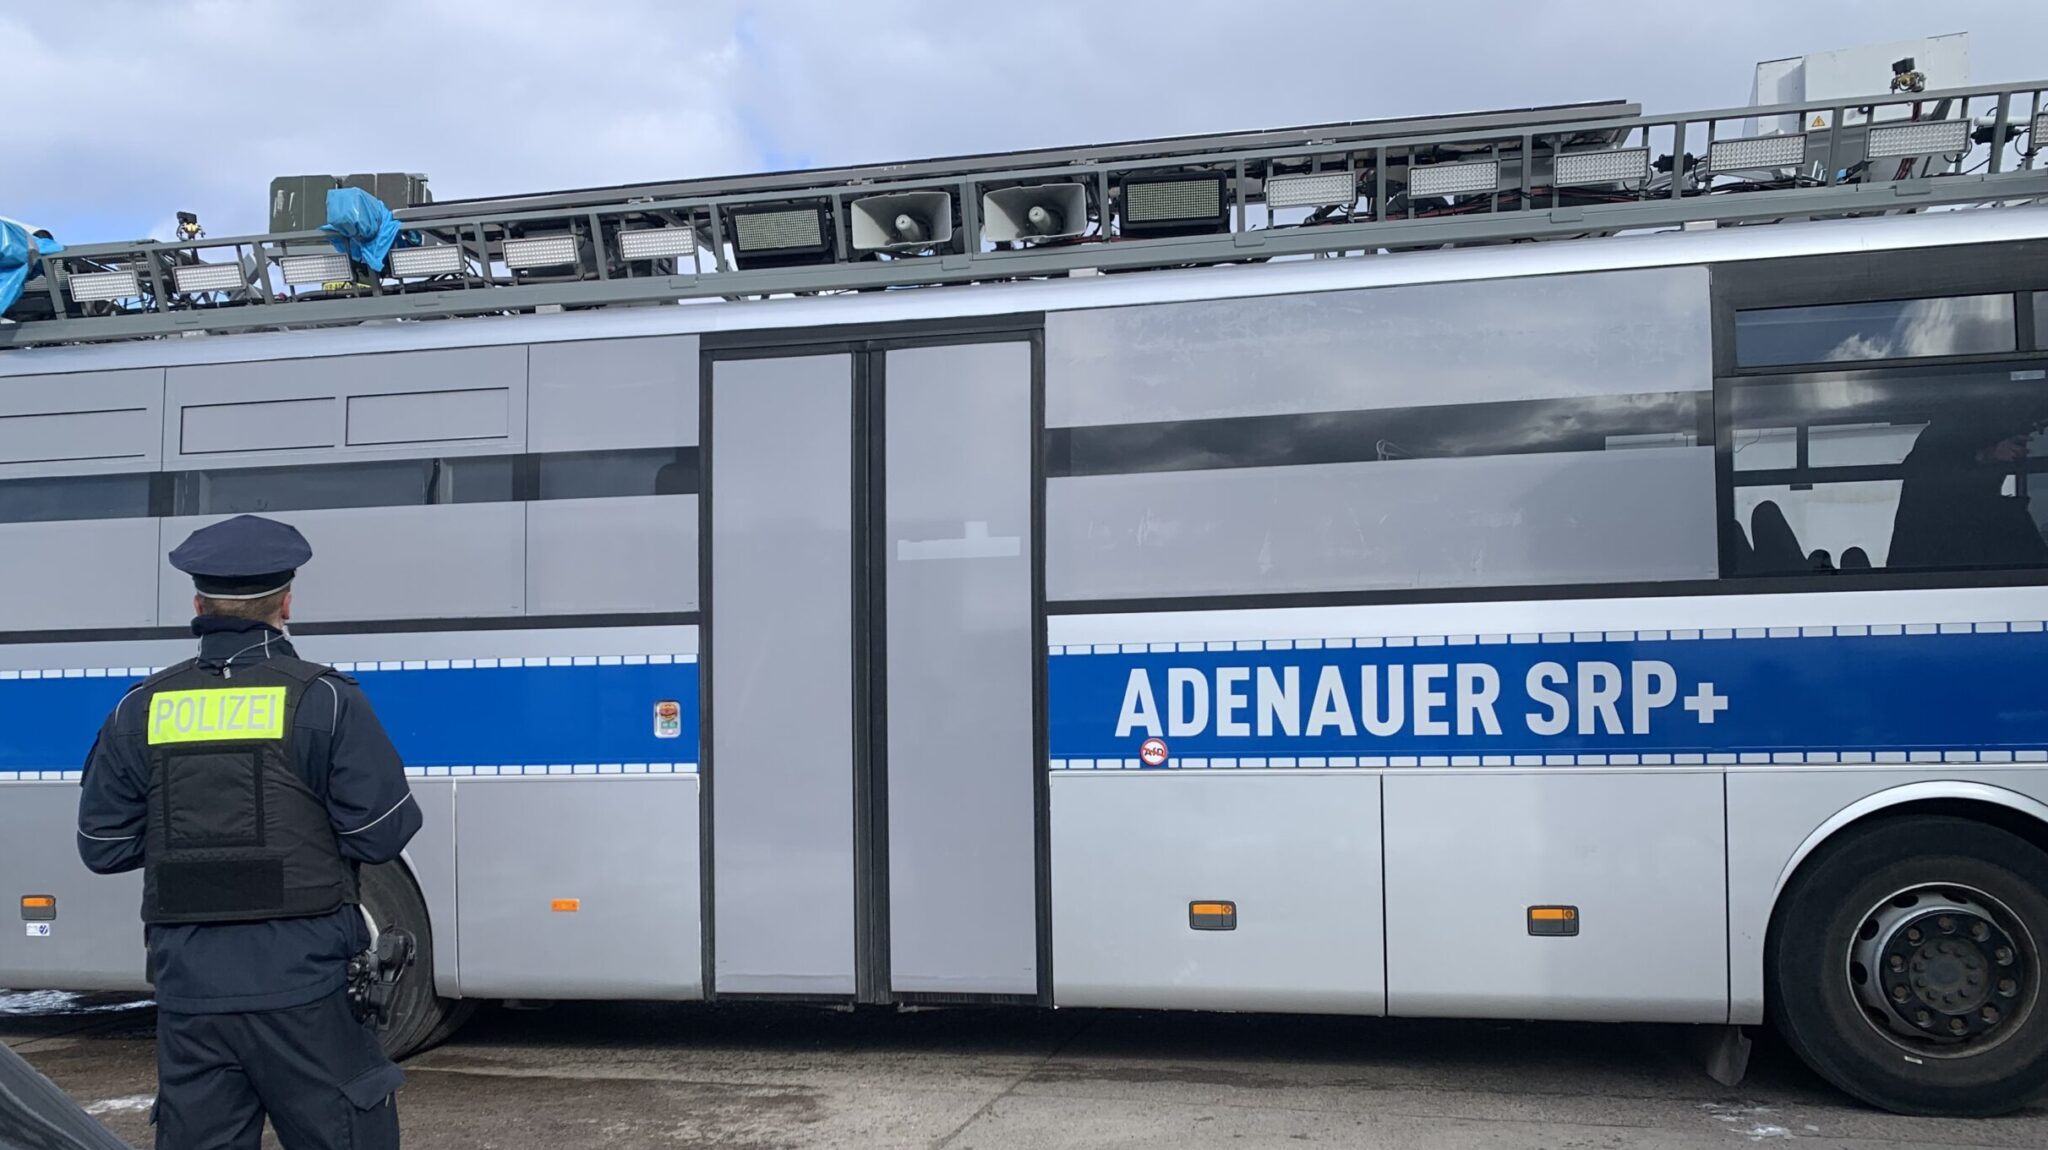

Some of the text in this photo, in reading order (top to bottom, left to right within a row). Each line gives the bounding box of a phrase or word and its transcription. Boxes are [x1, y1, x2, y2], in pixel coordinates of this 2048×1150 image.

[154, 694, 277, 735] POLIZEI
[1115, 660, 1729, 737] ADENAUER SRP+
